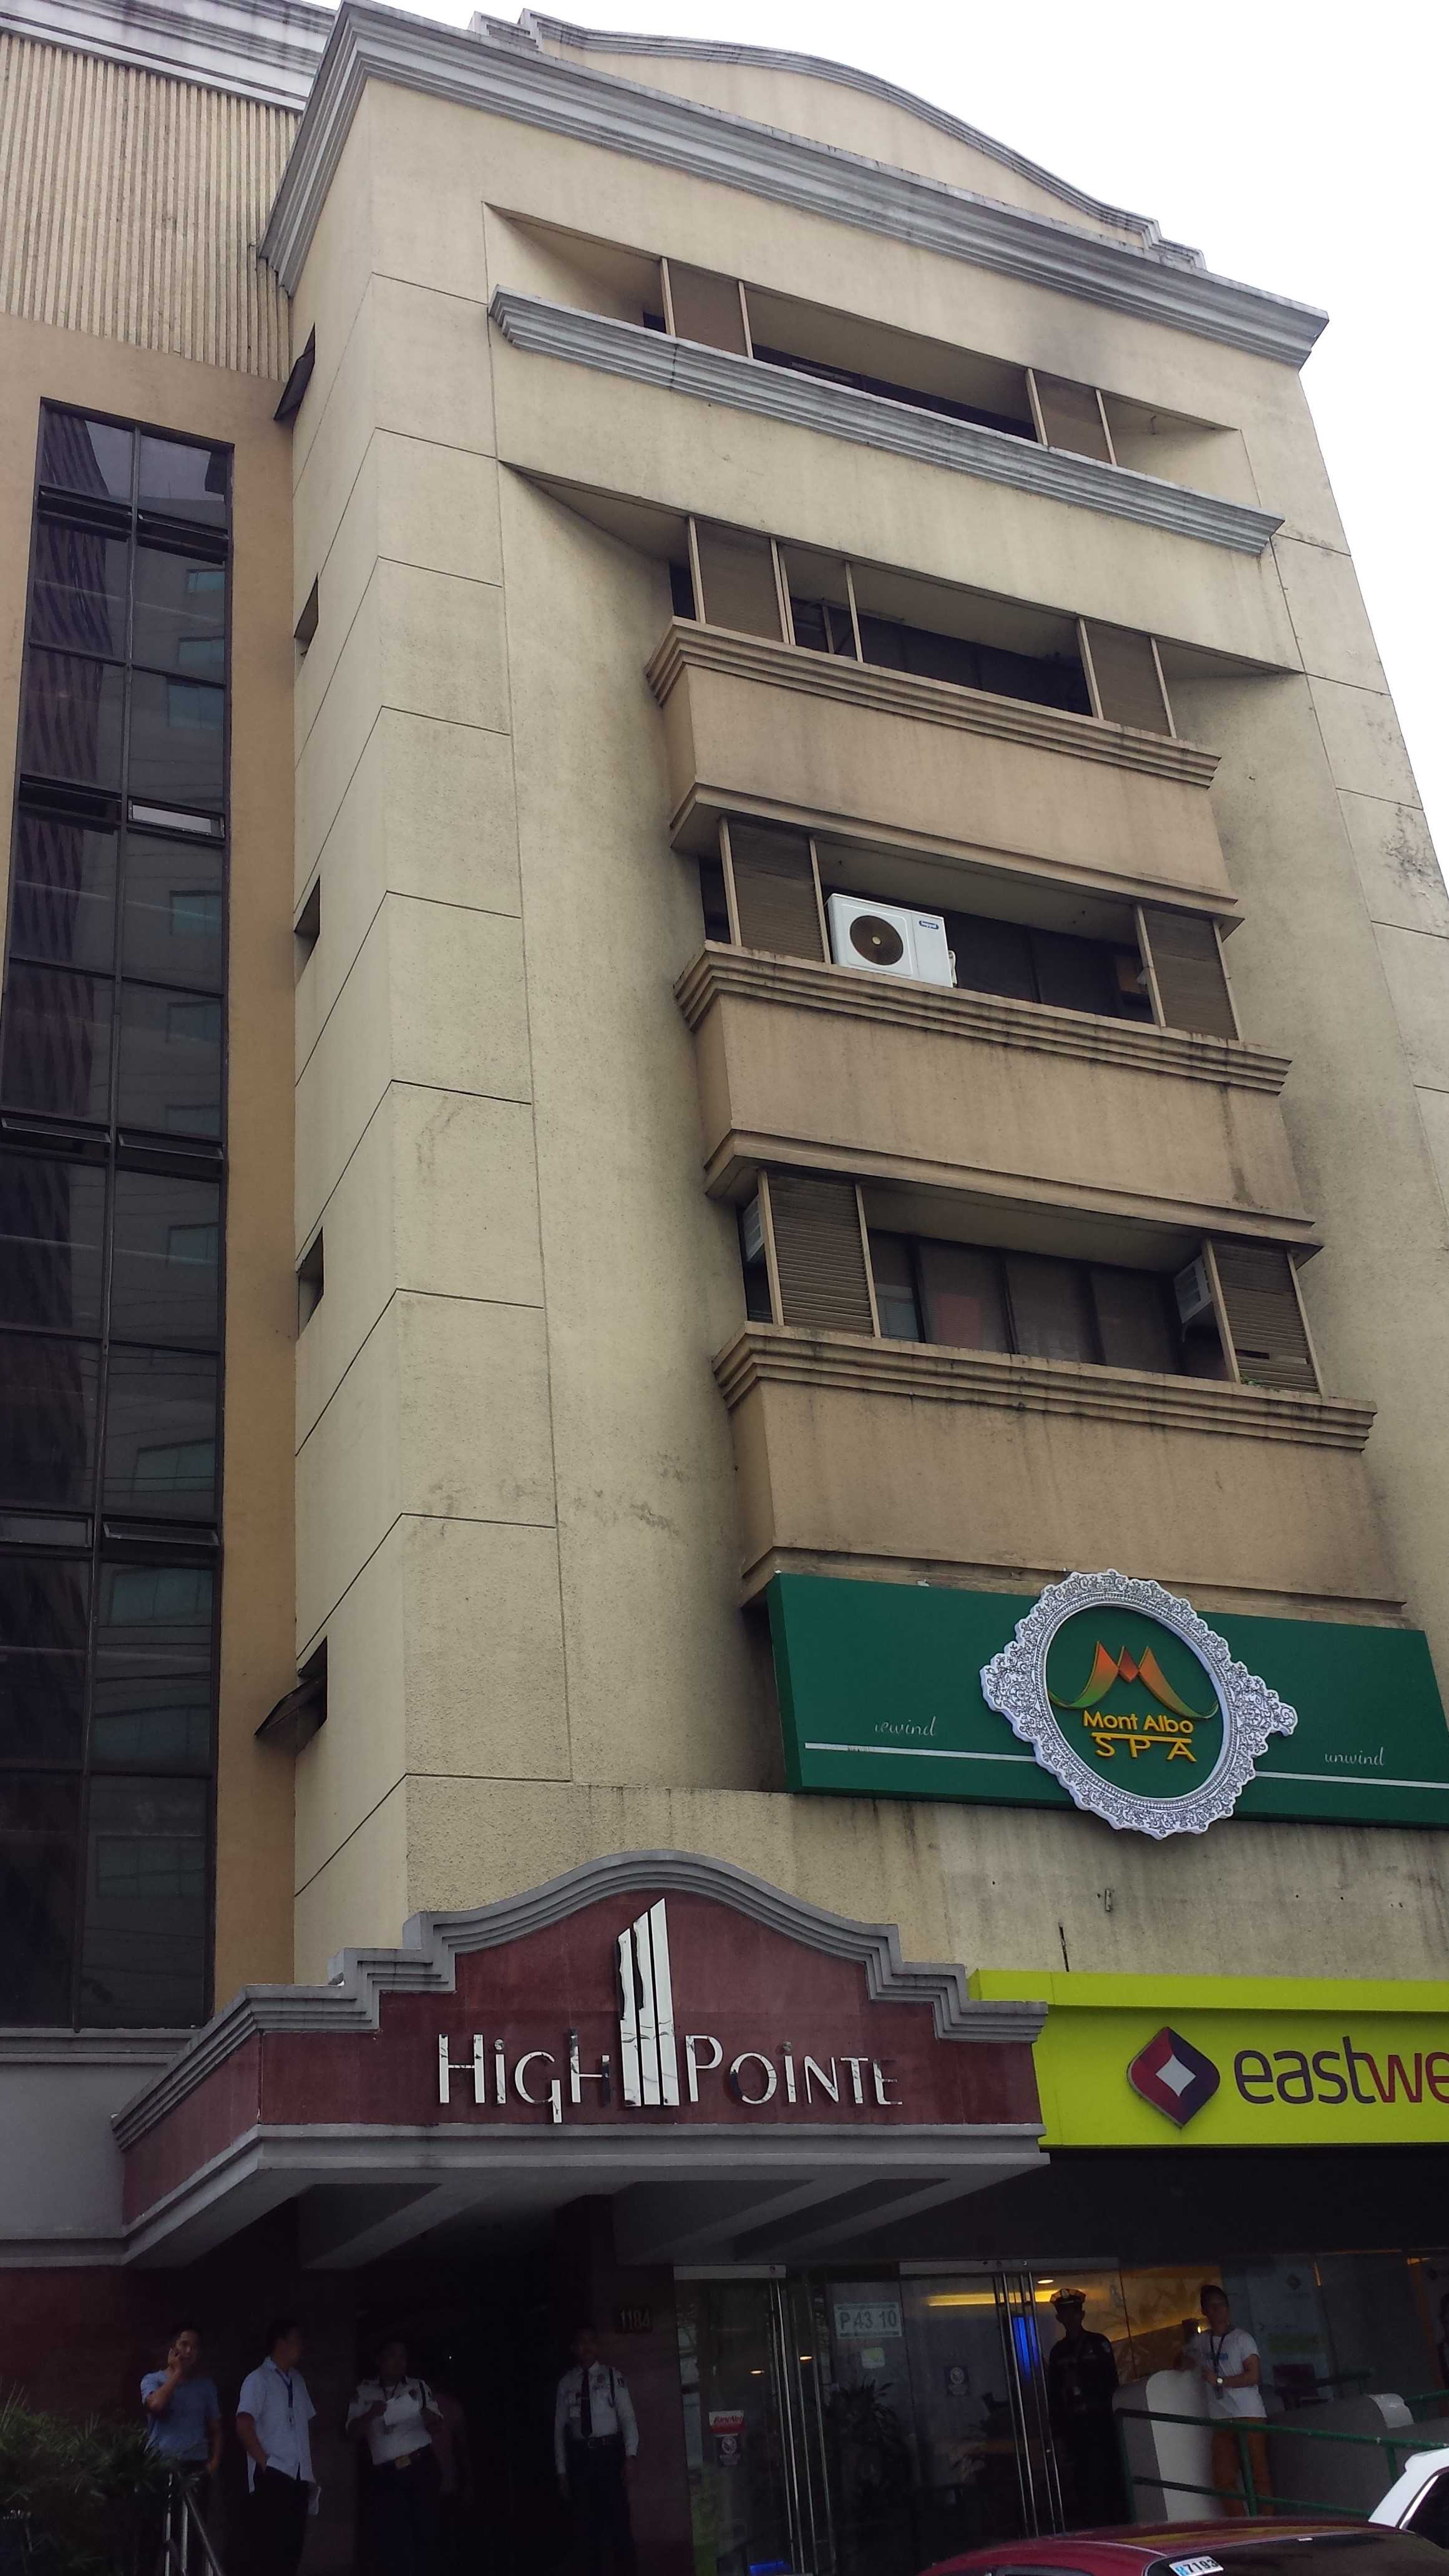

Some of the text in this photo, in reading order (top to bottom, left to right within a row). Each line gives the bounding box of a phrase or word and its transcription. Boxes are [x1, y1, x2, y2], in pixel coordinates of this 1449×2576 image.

[1083, 1710, 1194, 1734] Mont Albo
[1095, 1735, 1197, 1762] SPA
[1324, 1747, 1384, 1766] unwind
[1234, 2036, 1449, 2104] eastwe
